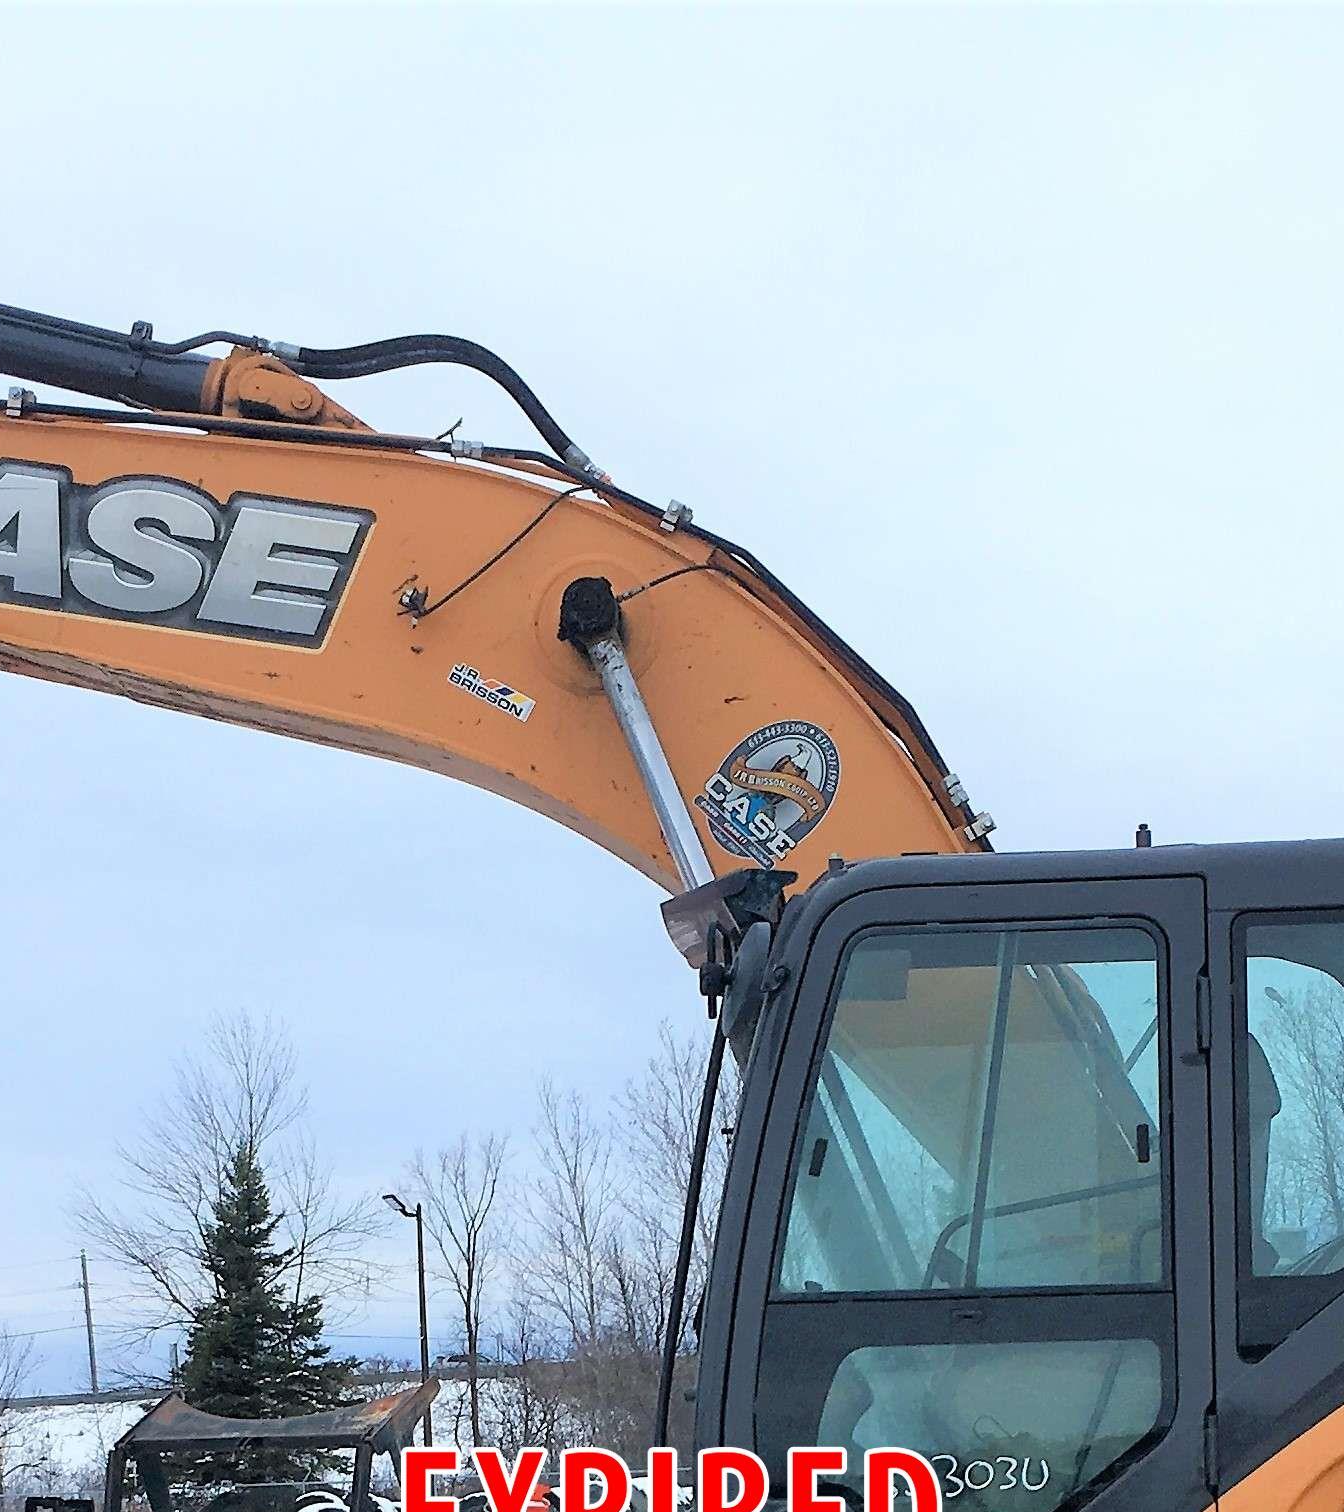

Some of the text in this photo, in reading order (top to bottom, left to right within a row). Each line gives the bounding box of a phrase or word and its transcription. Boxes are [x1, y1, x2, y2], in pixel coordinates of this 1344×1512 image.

[449, 671, 524, 717] BRISSON
[454, 664, 480, 682] J.R.
[705, 773, 797, 860] CASE
